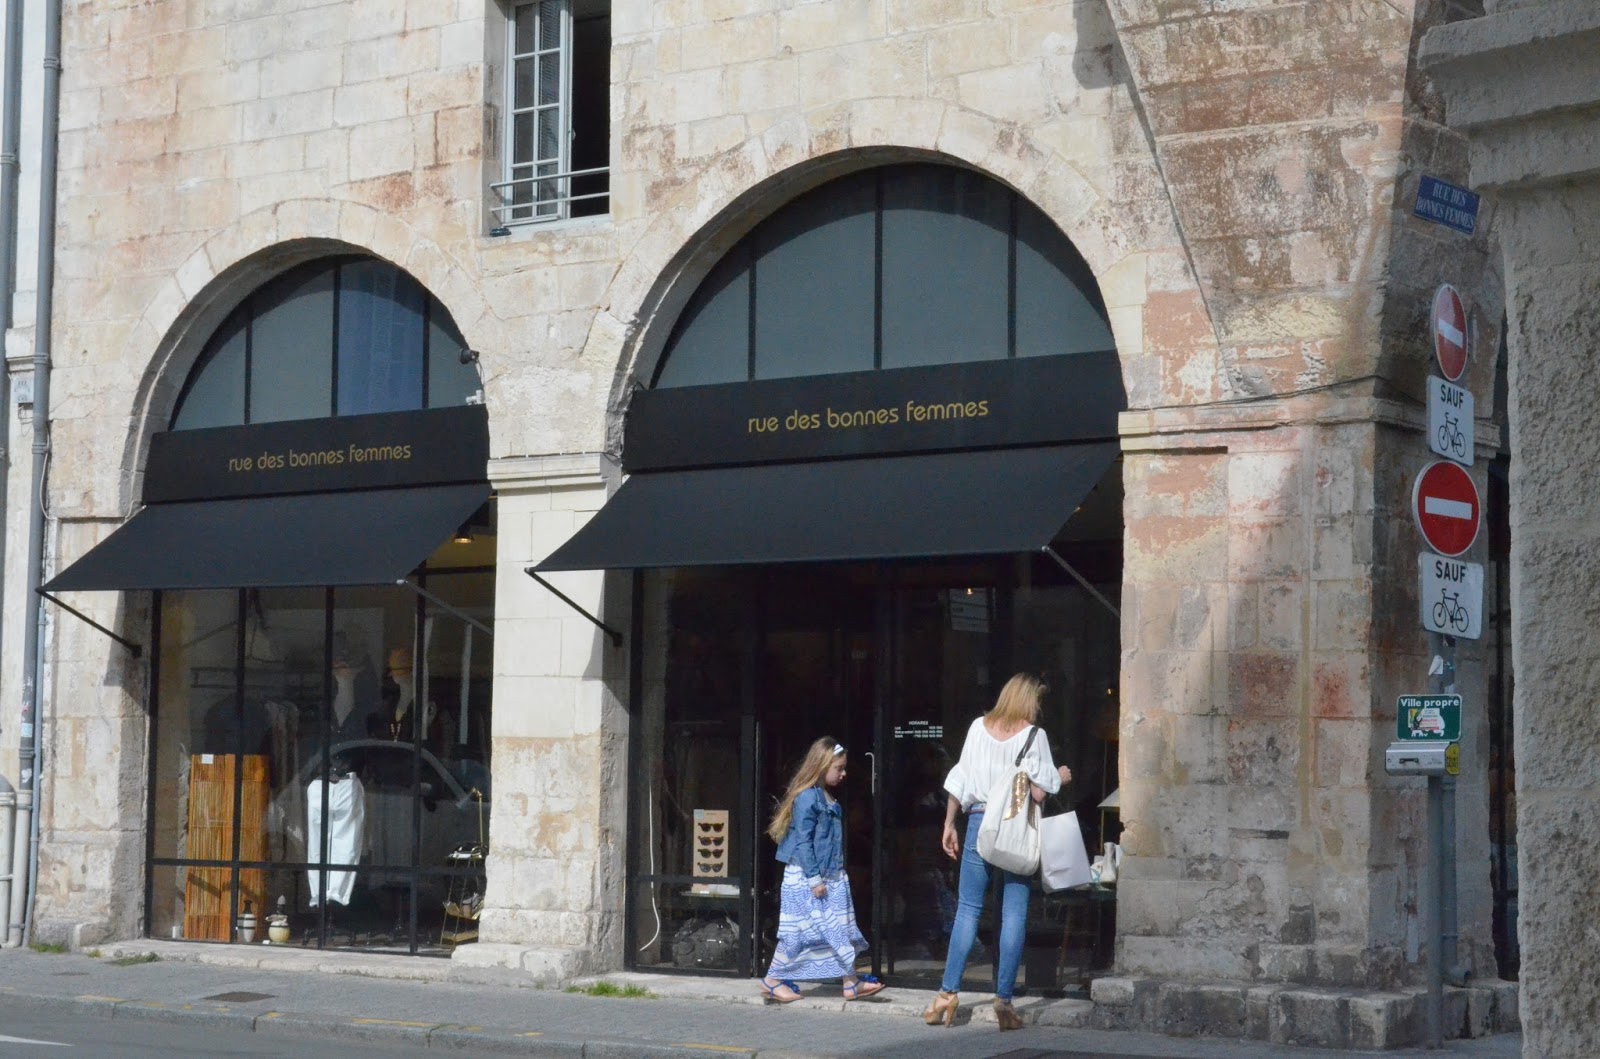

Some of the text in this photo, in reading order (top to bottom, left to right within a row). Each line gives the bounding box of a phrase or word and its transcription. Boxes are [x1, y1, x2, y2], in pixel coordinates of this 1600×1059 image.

[1432, 182, 1468, 206] RUE DES
[1415, 197, 1475, 229] BONNES FEMMES
[1440, 384, 1464, 410] SAUF
[748, 400, 989, 433] rue des bonnes femmes
[228, 444, 412, 472] rue des bonnes femmes
[1435, 559, 1467, 583] SAUF
[1400, 698, 1460, 709] Ville propre
